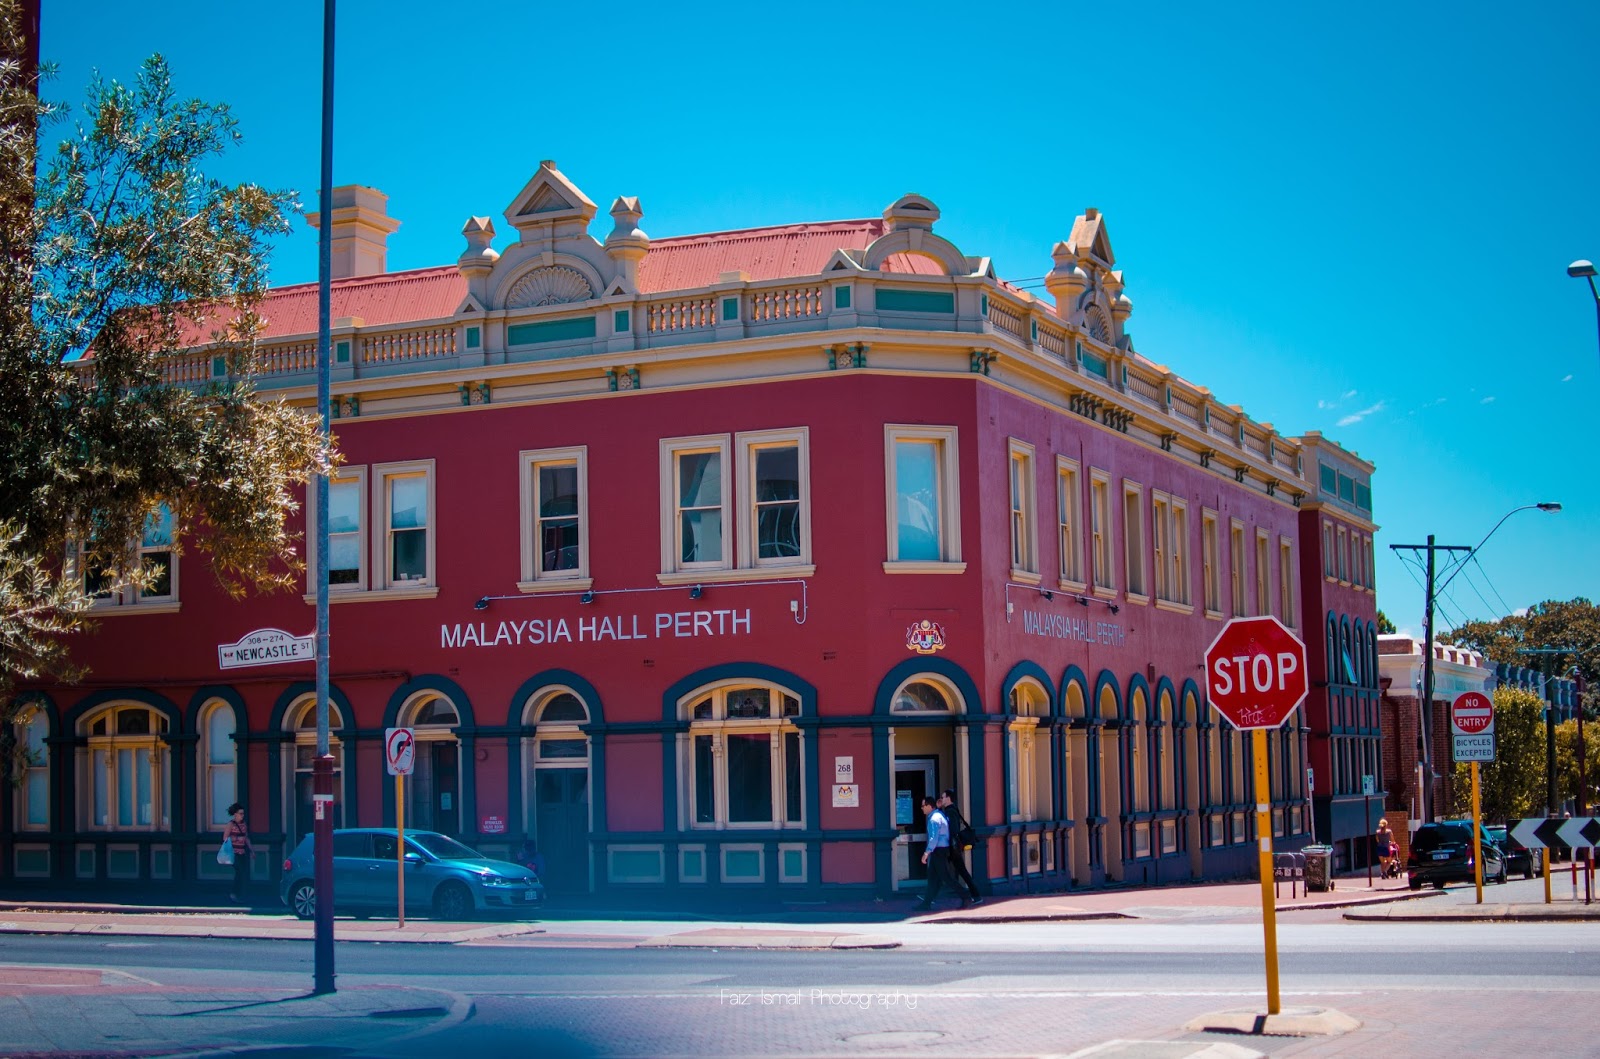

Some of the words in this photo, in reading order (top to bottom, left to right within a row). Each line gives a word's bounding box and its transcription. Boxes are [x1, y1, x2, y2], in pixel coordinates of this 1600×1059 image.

[441, 618, 572, 648] MALAYSIA
[579, 614, 648, 642] HALL
[655, 608, 751, 638] PERTH
[1023, 609, 1072, 640] MALAYSIA
[1072, 617, 1096, 643] HALL
[1096, 621, 1125, 647] PERTH
[236, 644, 298, 661] NEWCASTLE
[301, 642, 309, 650] ST
[1214, 652, 1297, 696] STOP
[1465, 698, 1479, 707] NO
[1457, 717, 1488, 727] ENTRY
[1456, 739, 1491, 747] BICYCLES
[1456, 749, 1492, 757] EXCEPTED
[837, 764, 852, 773] 268
